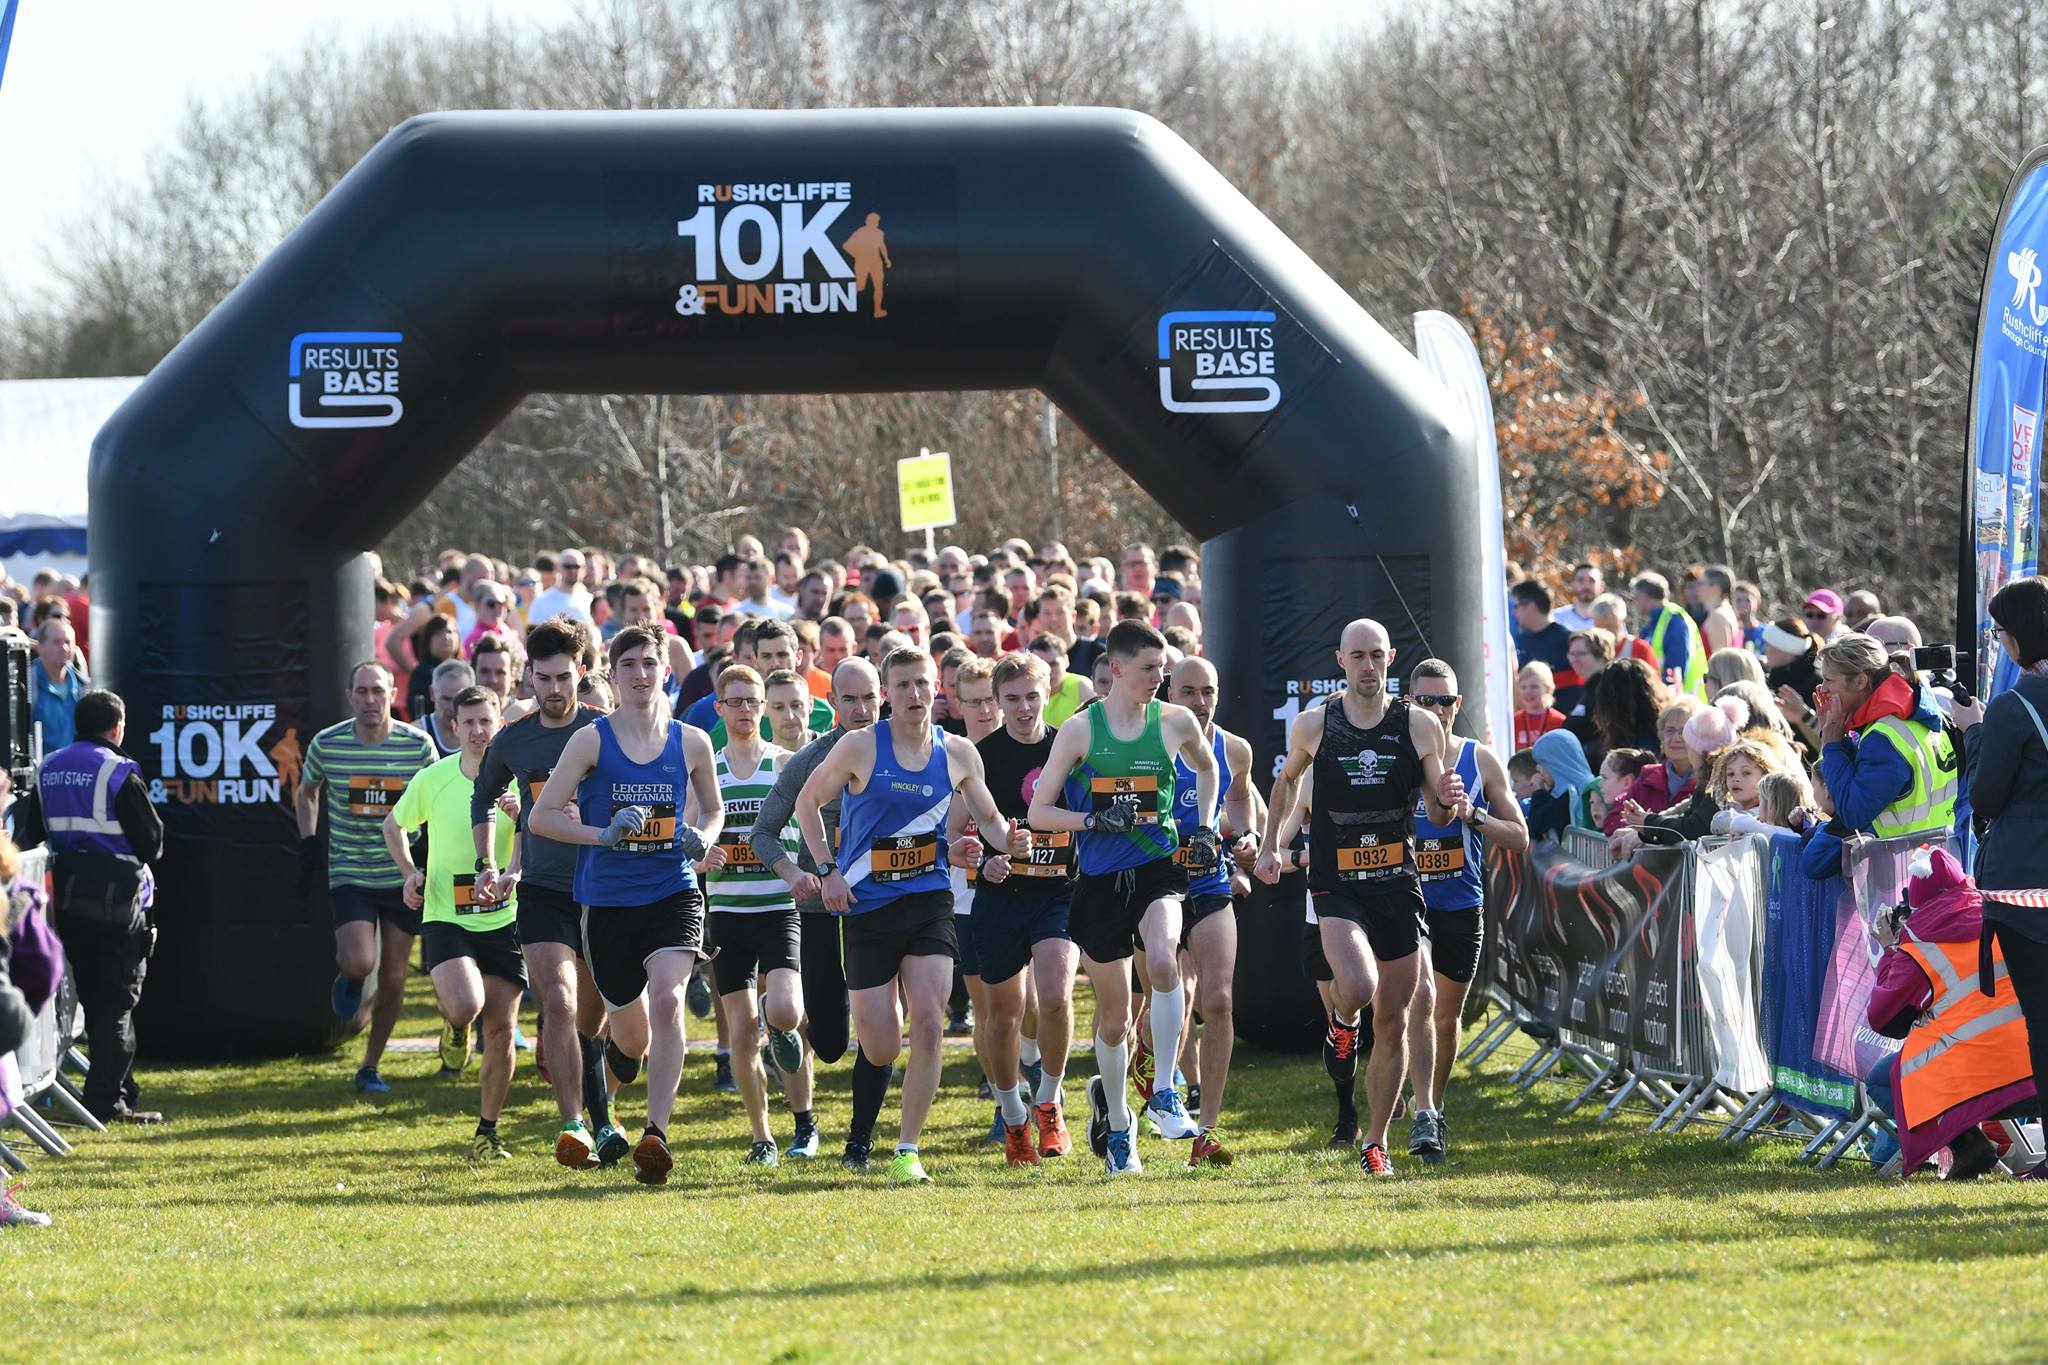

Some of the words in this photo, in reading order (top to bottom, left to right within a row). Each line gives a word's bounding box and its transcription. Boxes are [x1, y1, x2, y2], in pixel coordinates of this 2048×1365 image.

[698, 182, 851, 202] RUSHCLIFFE
[677, 201, 856, 281] 10K
[1175, 327, 1274, 351] RESULTS
[305, 348, 399, 369] RESULTS
[1196, 351, 1275, 376] BASE
[324, 371, 399, 393] BASE
[1287, 678, 1400, 694] RUSHCE
[162, 704, 277, 720] RUSHCLIFFE
[150, 719, 279, 779] 10K
[42, 771, 65, 787] EVENT
[64, 771, 94, 787] STAFF
[612, 783, 673, 793] LEICESTER
[365, 790, 387, 804] 1114
[612, 793, 673, 802] CORITANIAN
[732, 847, 760, 862] 093
[890, 850, 922, 868] 0781
[1030, 849, 1056, 864] 1127
[1353, 848, 1388, 867] 0932
[1417, 852, 1450, 869] 0389
